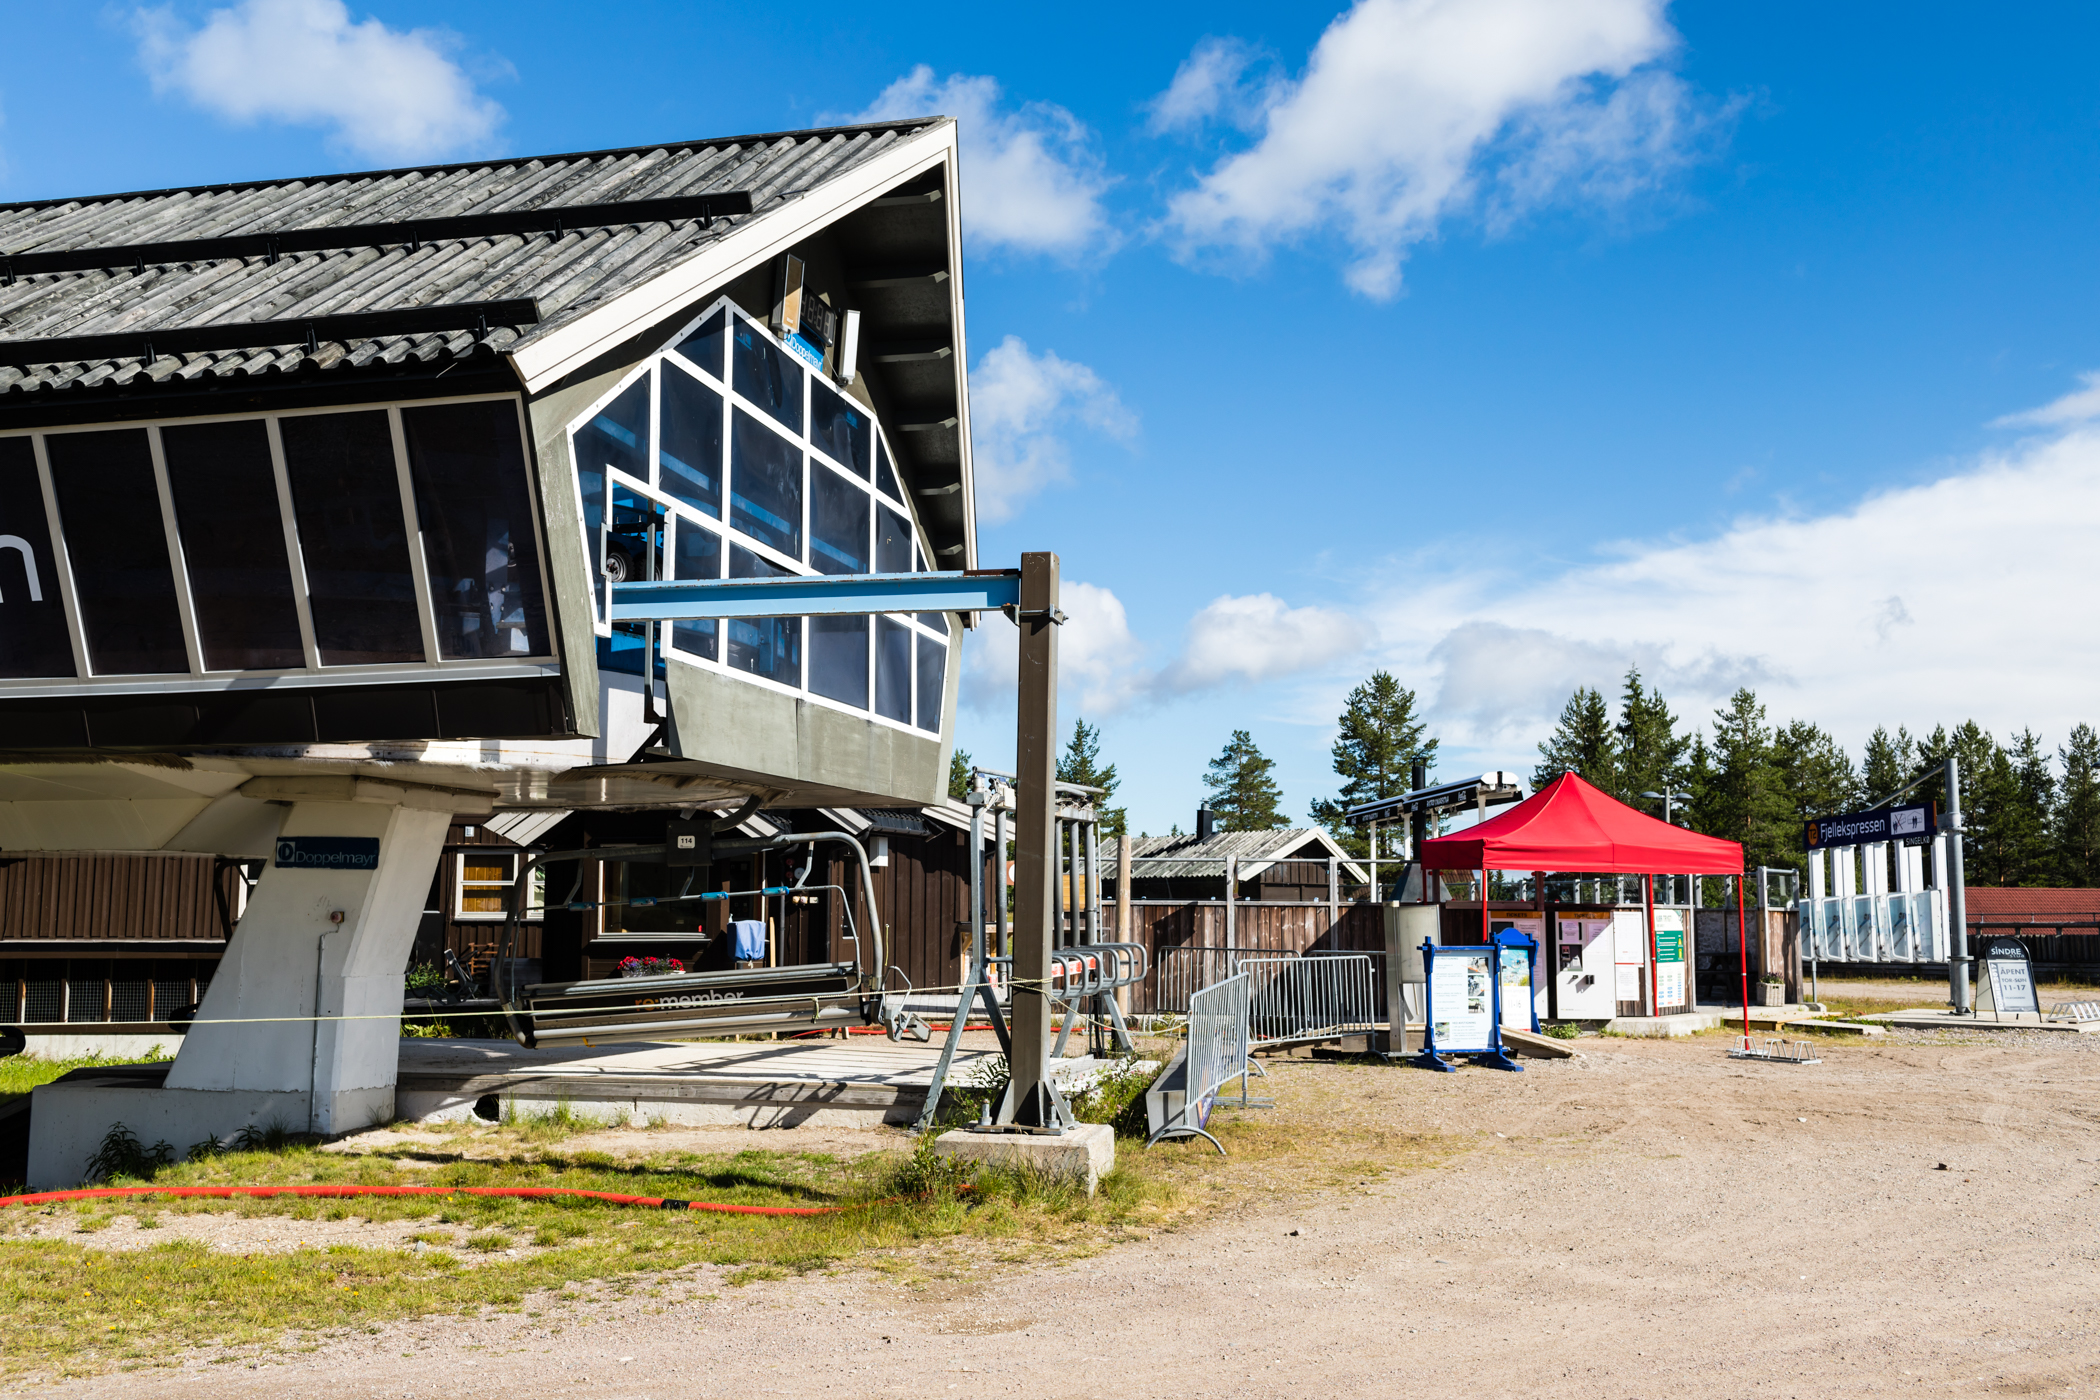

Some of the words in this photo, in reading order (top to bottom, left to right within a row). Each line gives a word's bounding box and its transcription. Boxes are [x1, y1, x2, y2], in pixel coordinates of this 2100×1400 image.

[791, 336, 823, 370] Doppelmayr
[1809, 829, 1817, 840] T2
[1820, 819, 1885, 842] Fjellekspressen
[1905, 835, 1930, 846] SINGELKØ
[296, 851, 376, 866] Doppelmayr
[1991, 963, 1999, 981] 2017
[2000, 967, 2025, 975] ÅPENT
[635, 989, 744, 1012] re:member
